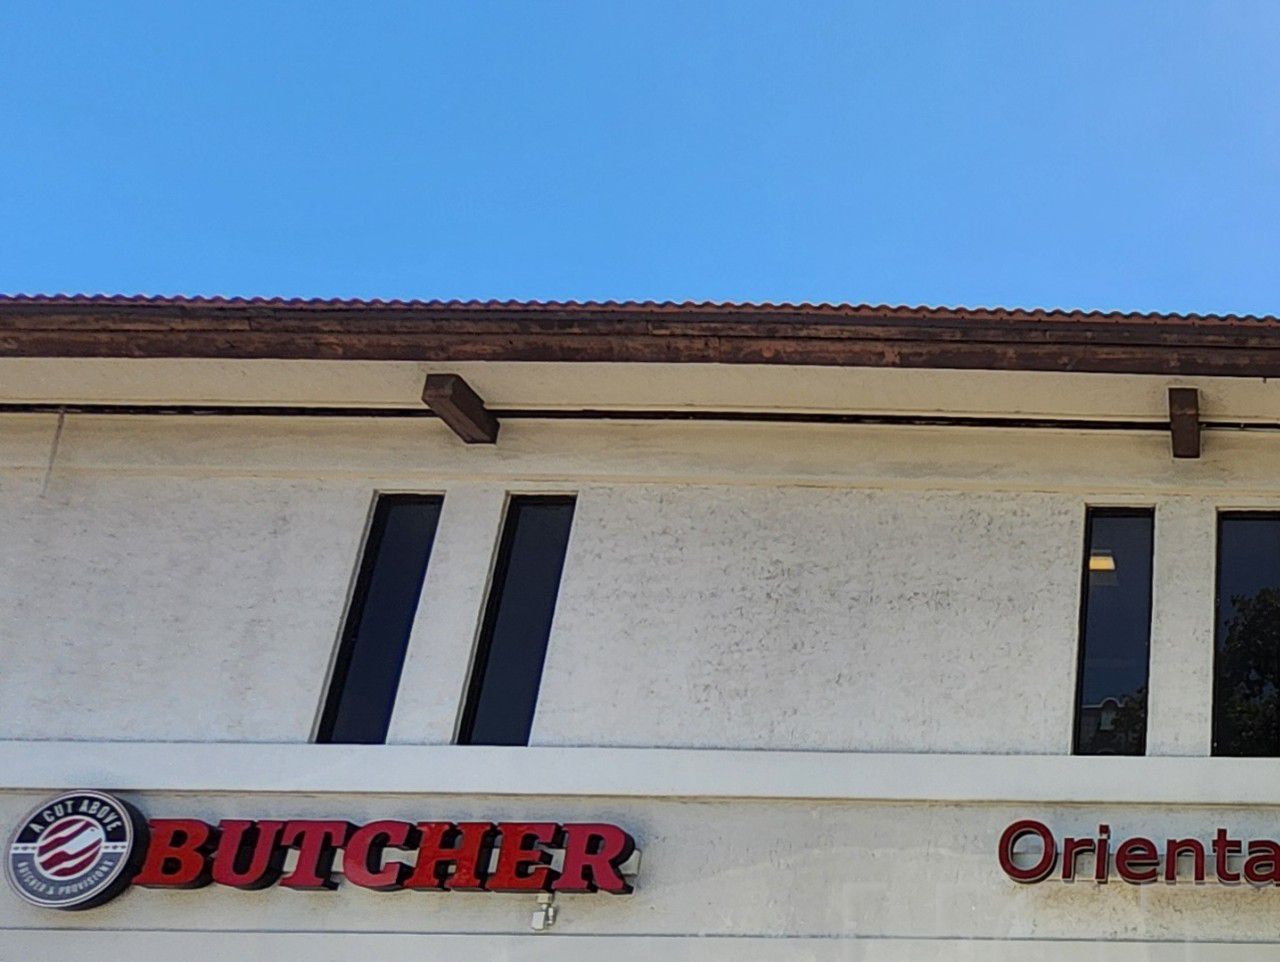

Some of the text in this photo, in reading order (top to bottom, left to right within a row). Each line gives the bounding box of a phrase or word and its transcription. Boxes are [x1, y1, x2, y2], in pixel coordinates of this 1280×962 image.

[29, 800, 122, 833] A CUT ABOVE
[133, 818, 632, 895] BUTCHER
